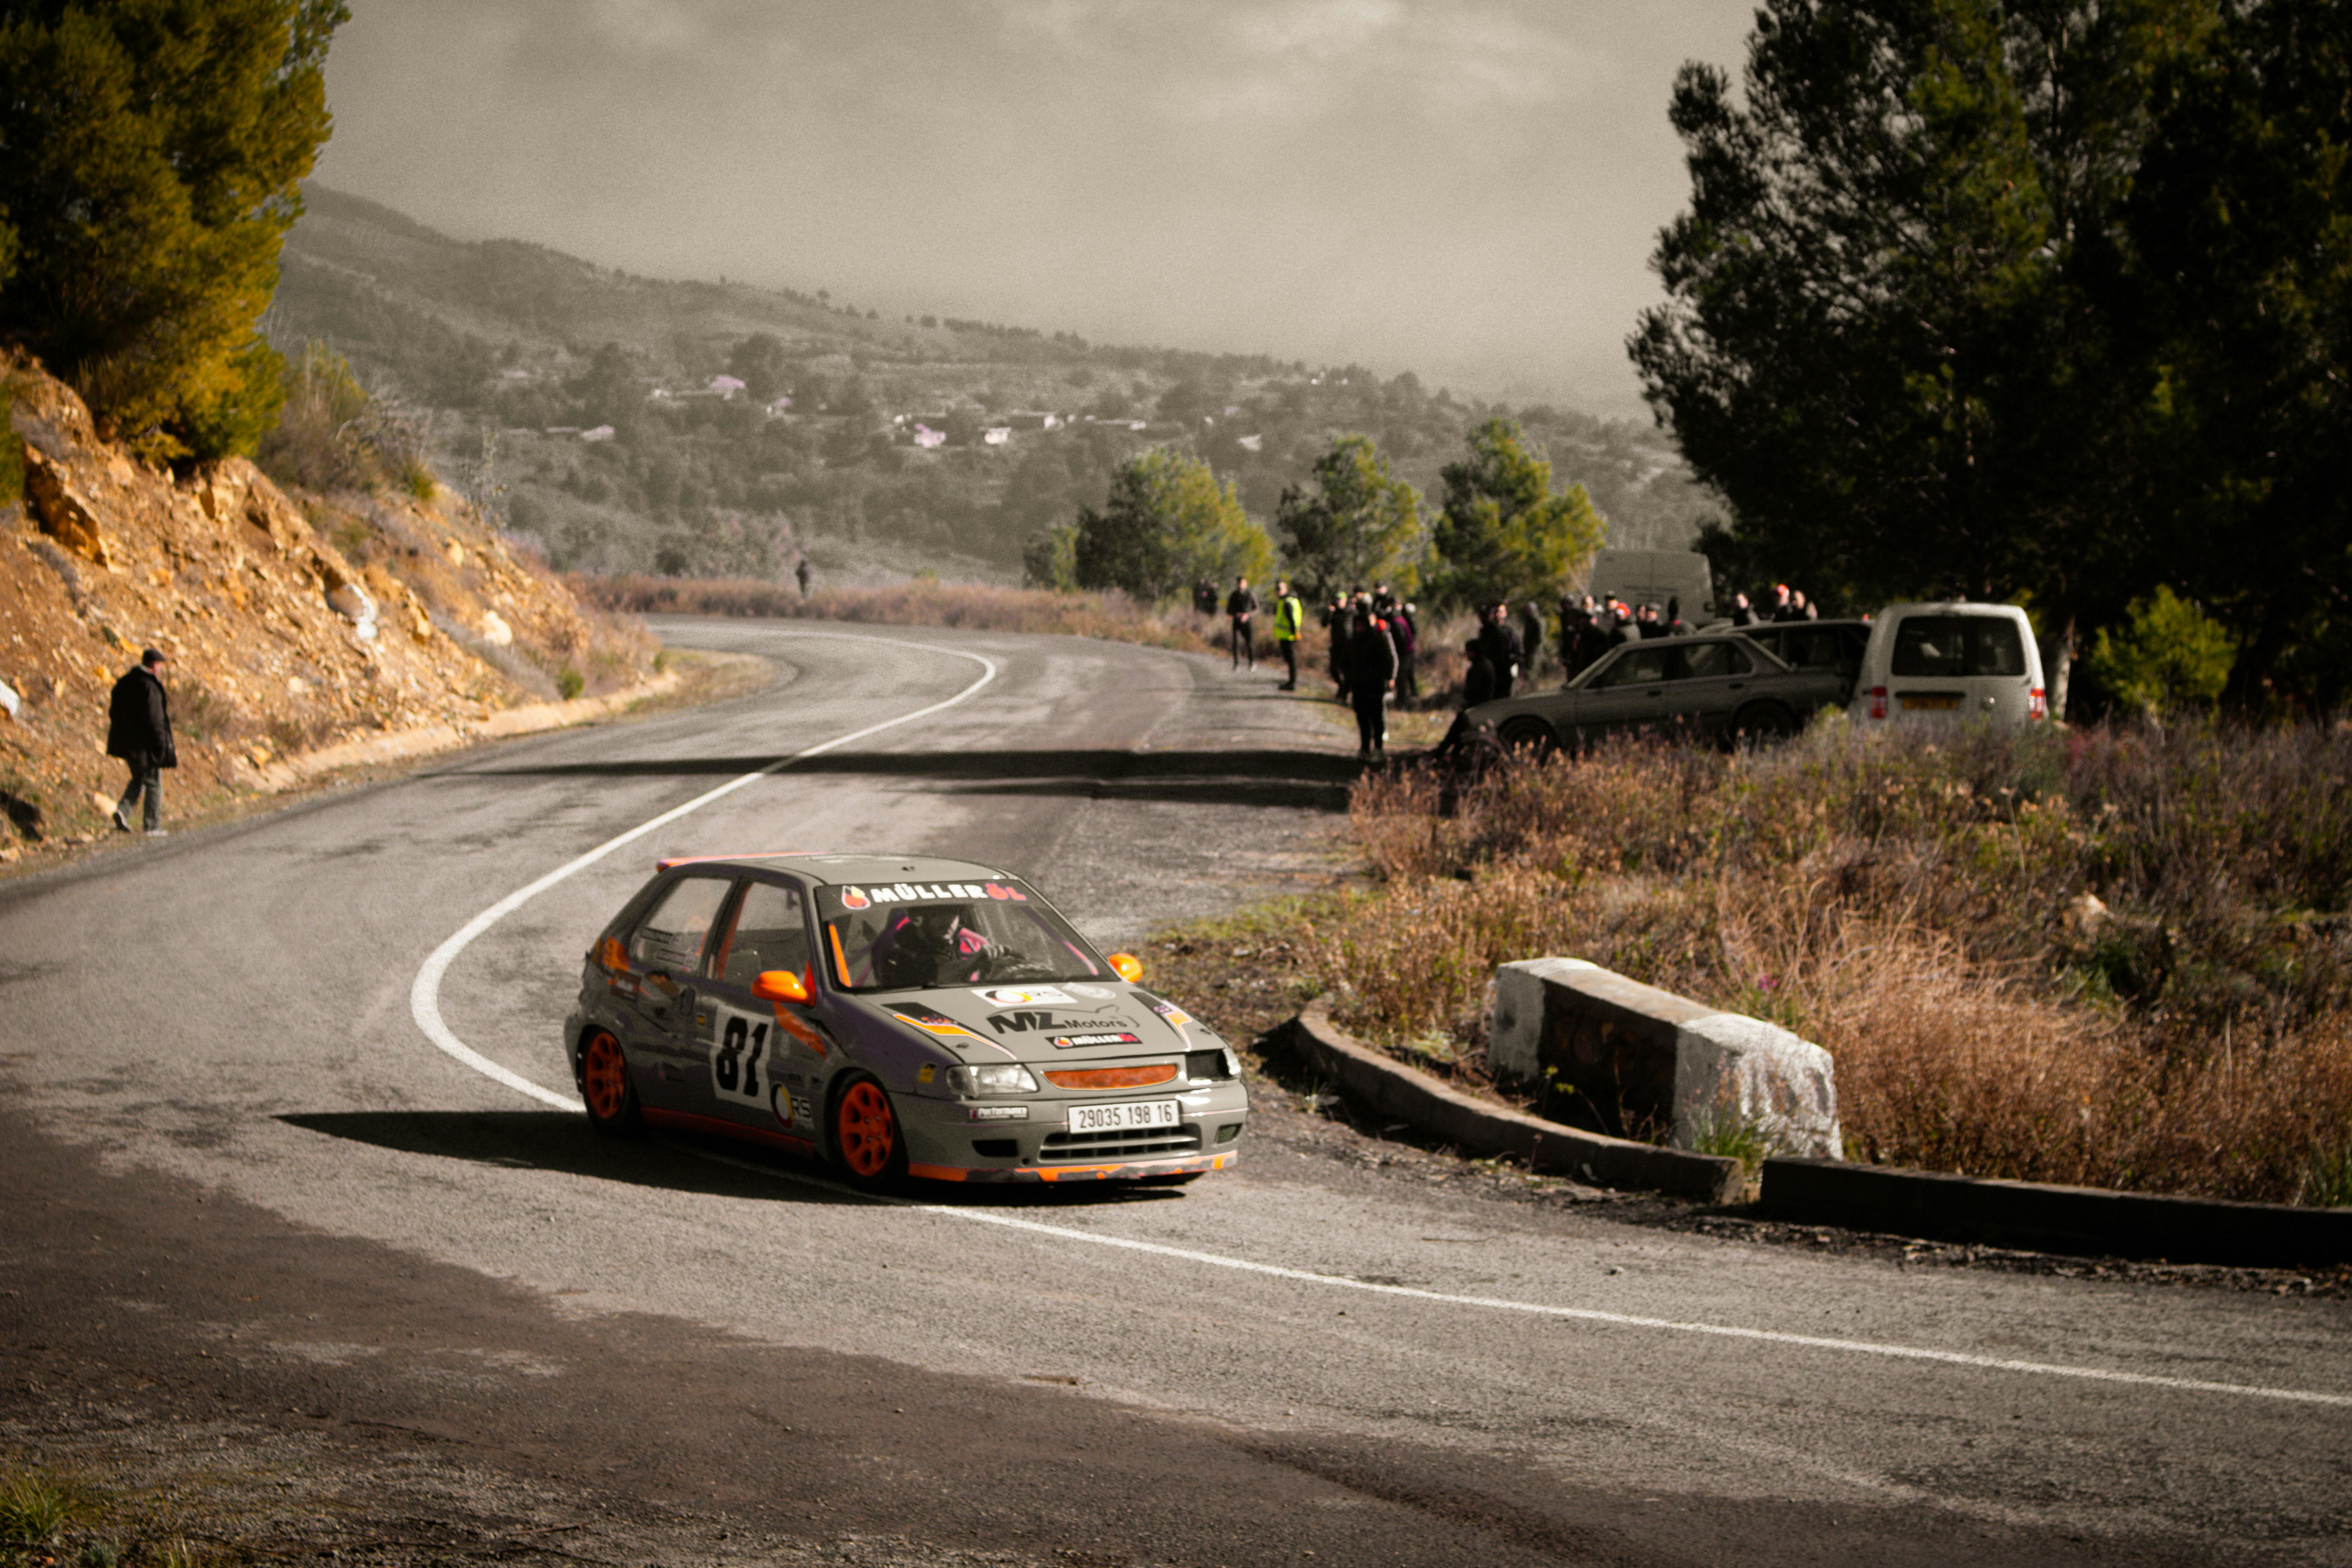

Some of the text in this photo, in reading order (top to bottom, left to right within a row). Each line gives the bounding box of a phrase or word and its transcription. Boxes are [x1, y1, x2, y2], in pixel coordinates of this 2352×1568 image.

[986, 1012, 1127, 1034] MZ Motors
[716, 1016, 768, 1097] 81
[1078, 1104, 1173, 1128] 29035 198 16
